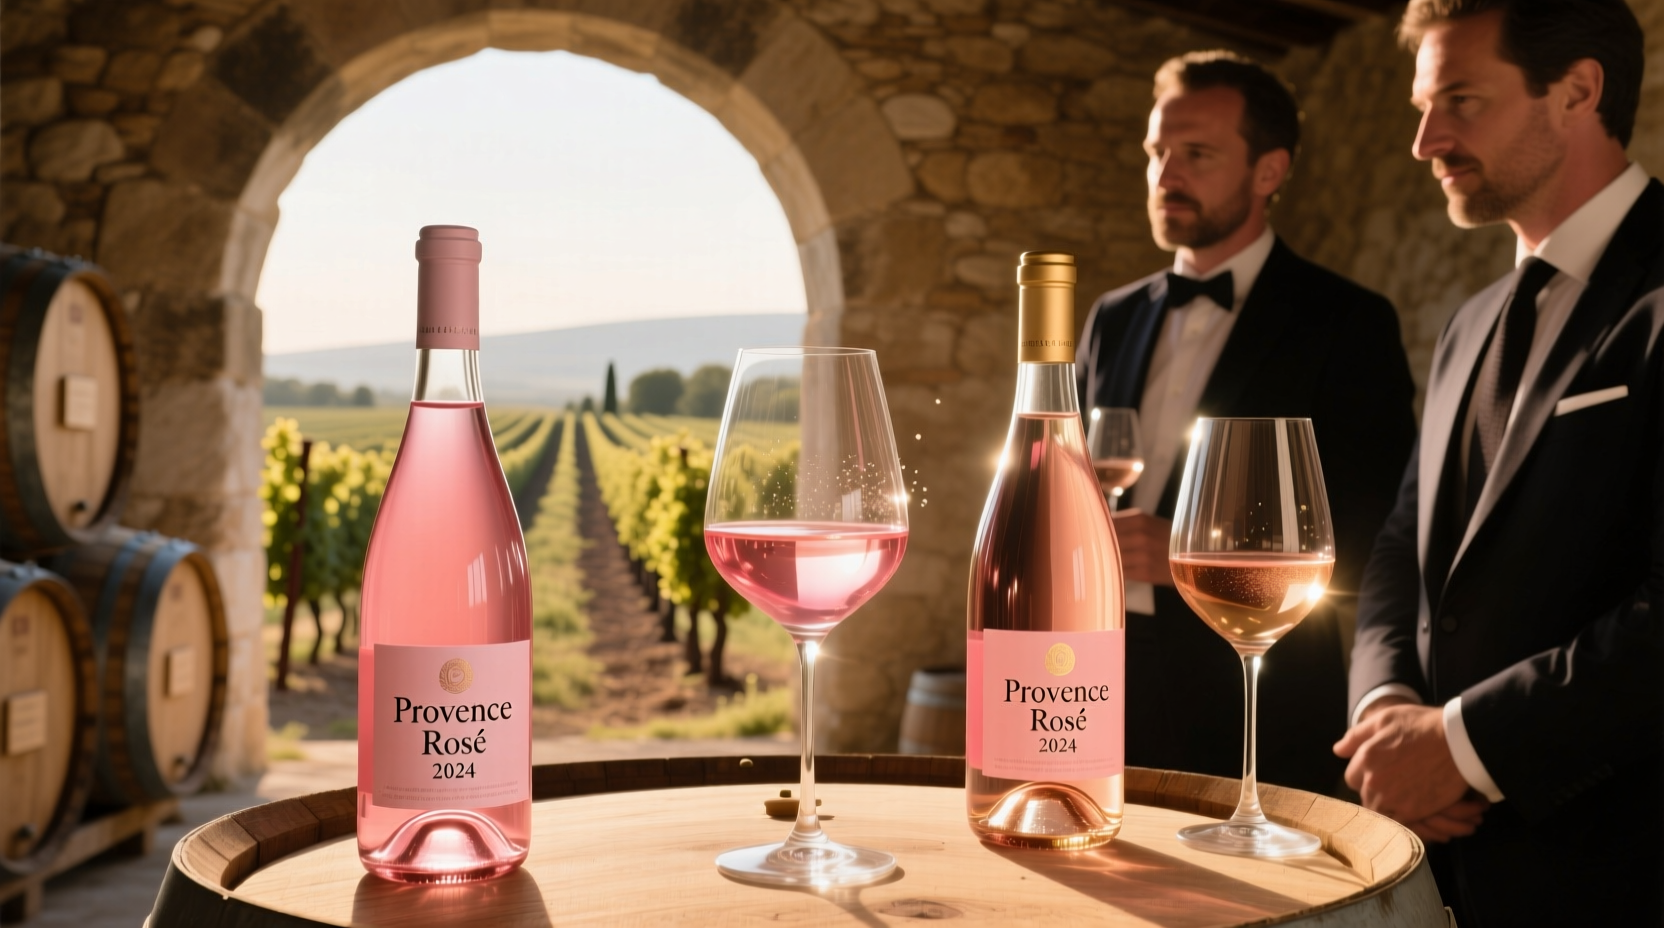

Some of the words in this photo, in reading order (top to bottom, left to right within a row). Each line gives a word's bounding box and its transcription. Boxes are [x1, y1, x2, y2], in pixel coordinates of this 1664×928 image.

[1004, 678, 1109, 703] Provence
[394, 696, 512, 724] Provence
[1030, 707, 1087, 732] Rosé
[422, 728, 487, 756] Rosé
[1039, 737, 1077, 753] 2024
[432, 762, 476, 779] 2024
